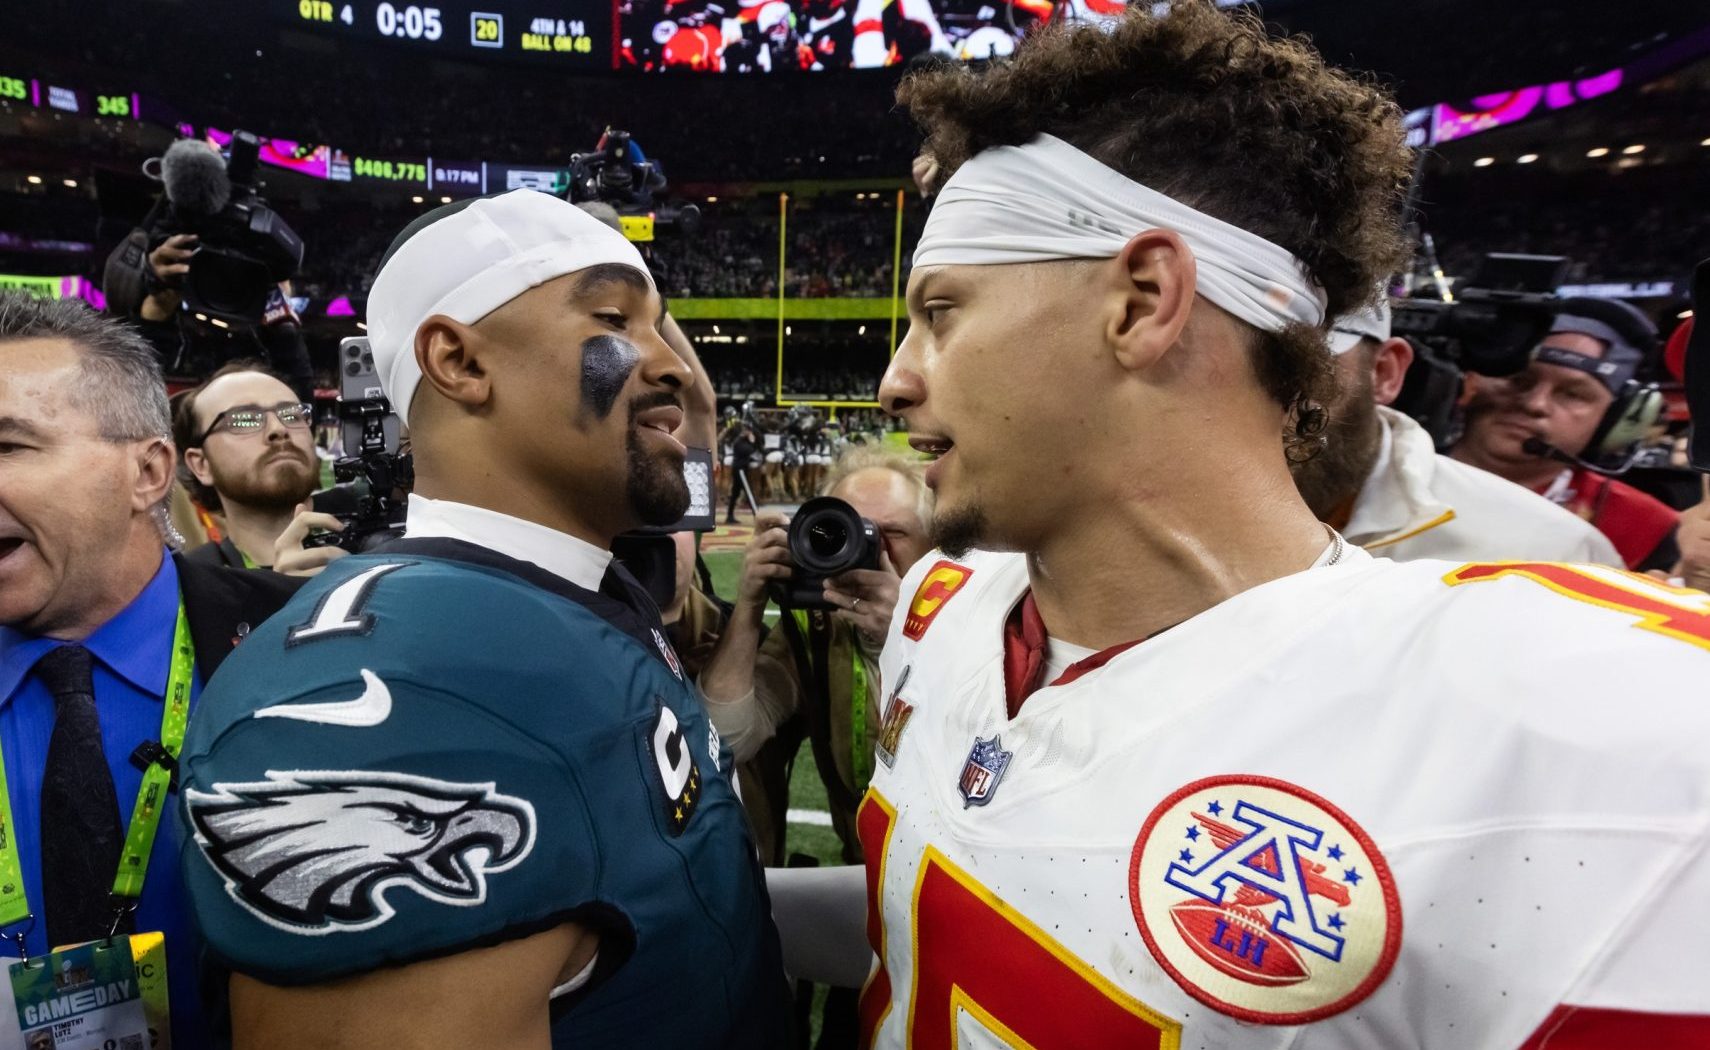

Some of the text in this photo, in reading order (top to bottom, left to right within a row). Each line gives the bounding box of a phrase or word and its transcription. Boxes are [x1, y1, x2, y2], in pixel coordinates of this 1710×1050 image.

[340, 4, 354, 25] 4
[376, 2, 443, 41] 0:05
[530, 18, 585, 37] 4TH & 14
[476, 19, 499, 39] 20
[521, 32, 552, 51] BALL
[554, 35, 573, 52] ON
[97, 95, 129, 115] 345
[460, 169, 479, 183] PM
[287, 563, 410, 646] 1
[912, 567, 964, 617] C
[653, 706, 692, 800] C
[961, 761, 993, 797] NFL
[24, 979, 130, 1025] GAMEDAY
